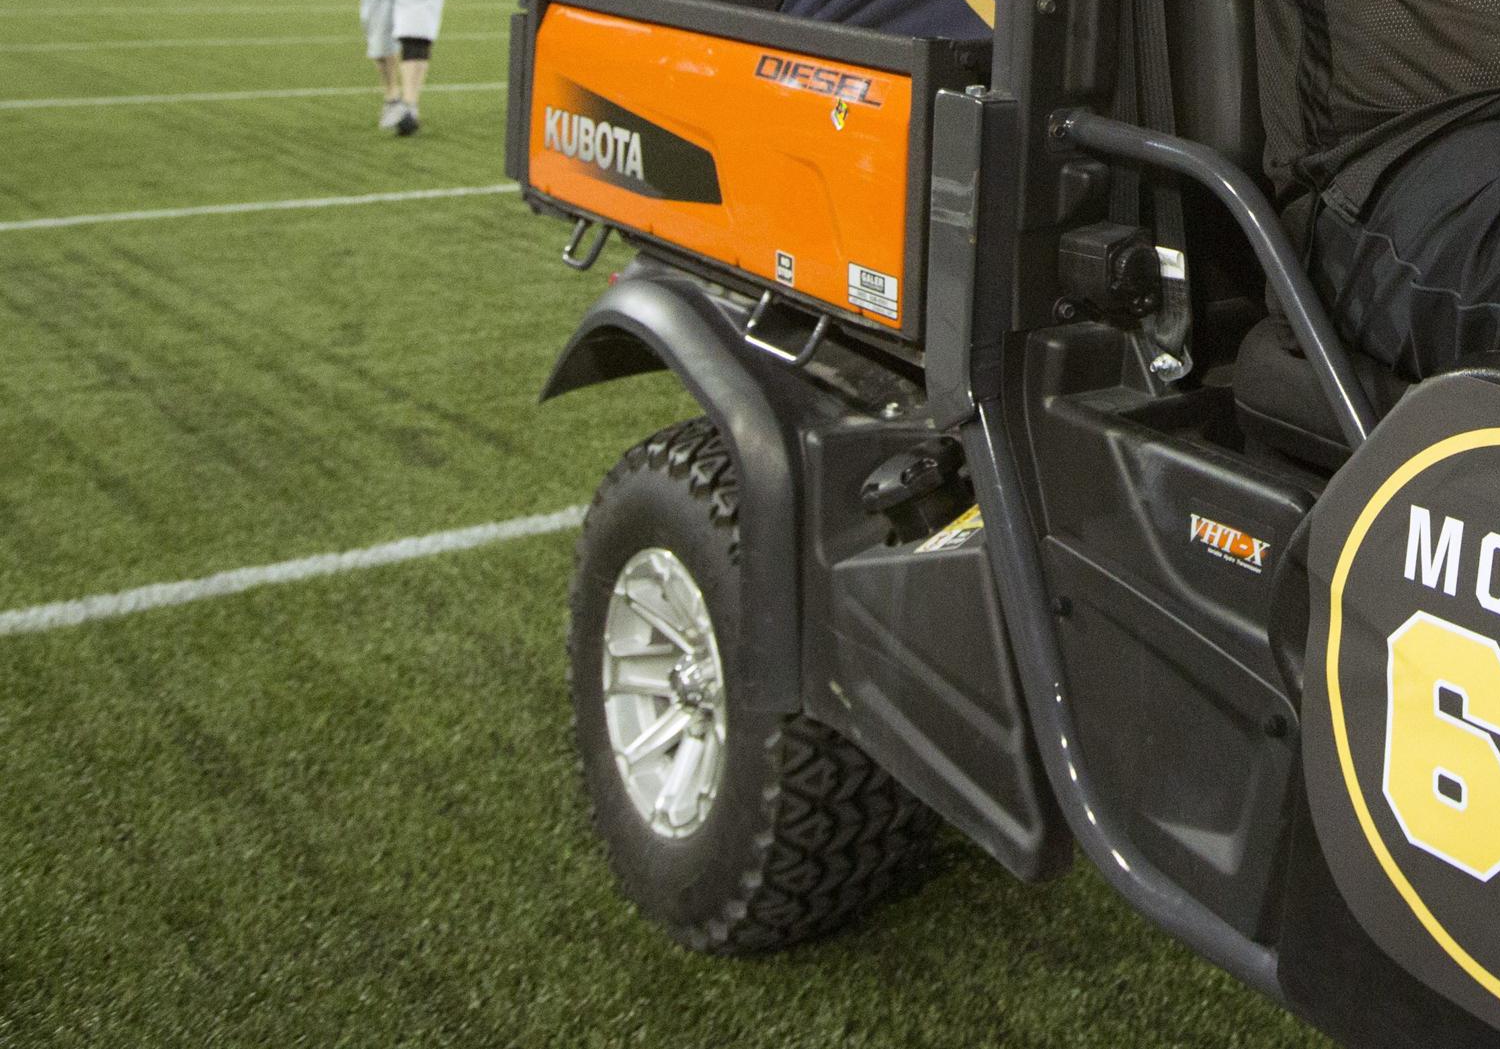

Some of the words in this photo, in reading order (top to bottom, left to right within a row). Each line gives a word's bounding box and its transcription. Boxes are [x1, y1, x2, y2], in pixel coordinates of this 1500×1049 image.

[755, 54, 882, 107] DIESEL
[544, 105, 645, 182] KUBOTA
[1190, 513, 1271, 566] VHT-X
